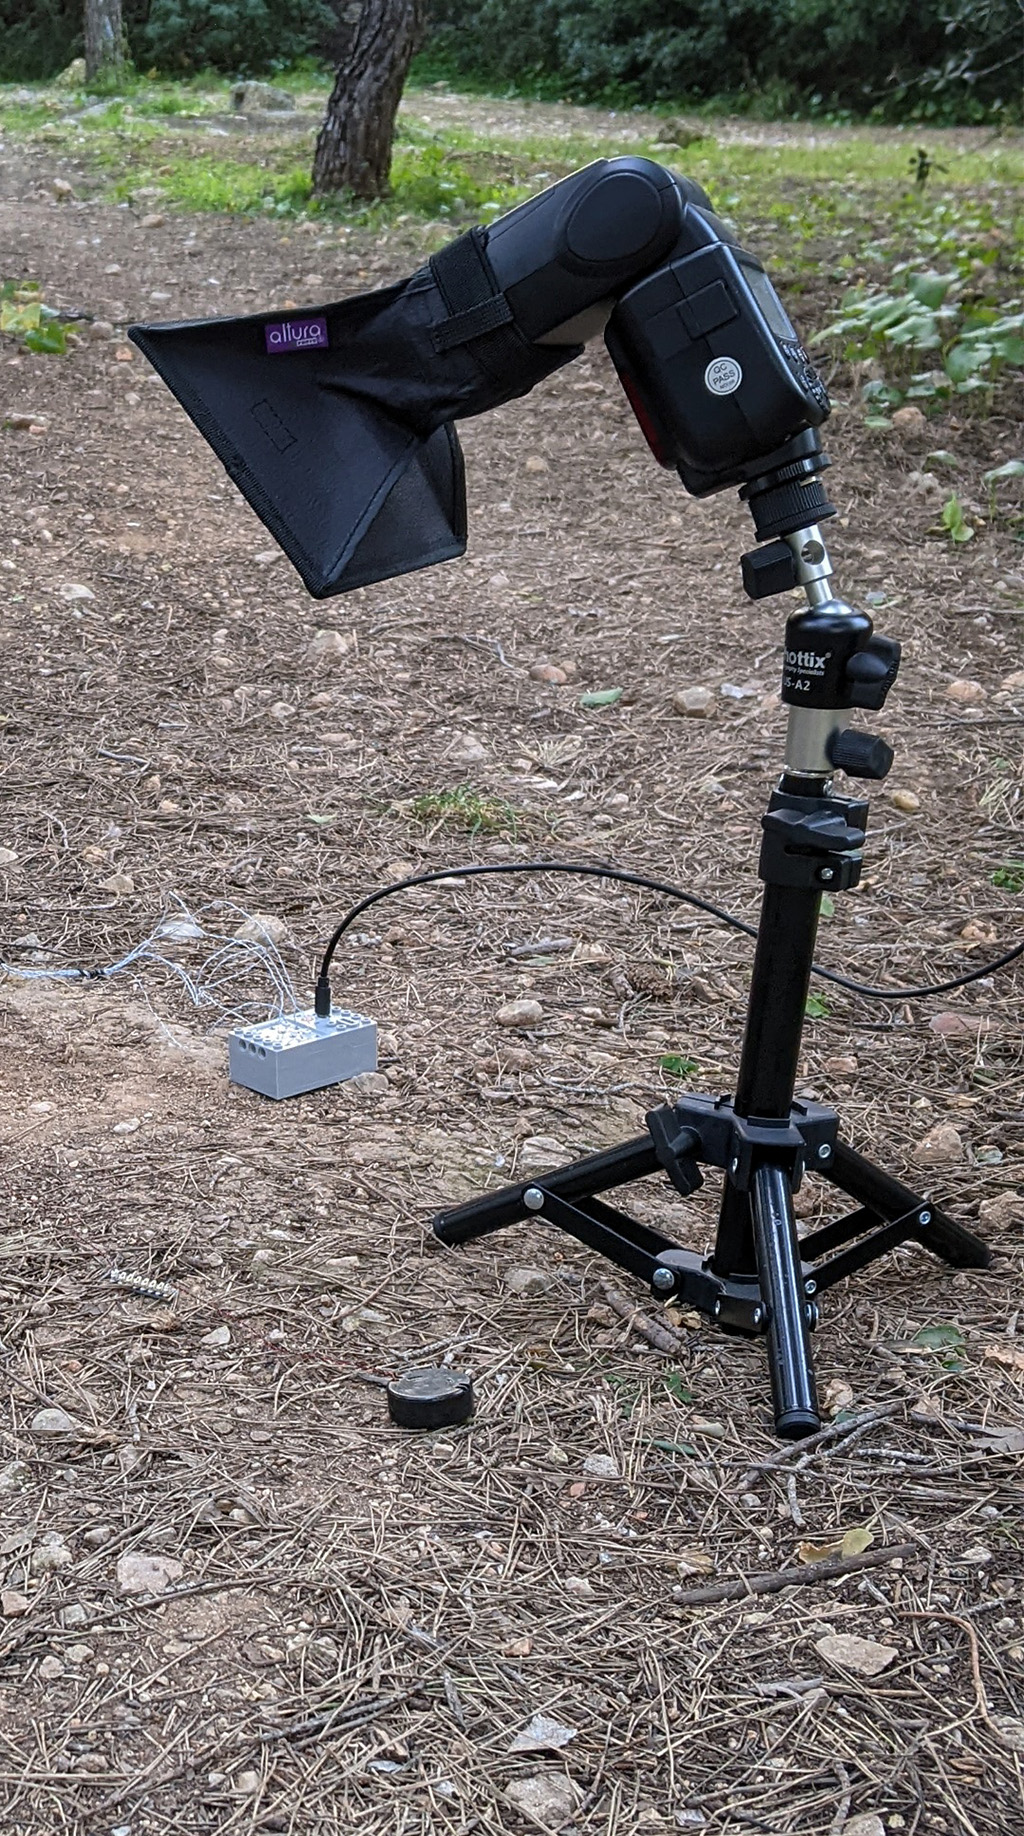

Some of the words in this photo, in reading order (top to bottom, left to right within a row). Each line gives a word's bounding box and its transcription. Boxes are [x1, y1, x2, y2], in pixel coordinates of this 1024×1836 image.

[269, 322, 321, 344] altura
[712, 369, 736, 385] PASS
[784, 676, 811, 691] S-A2
